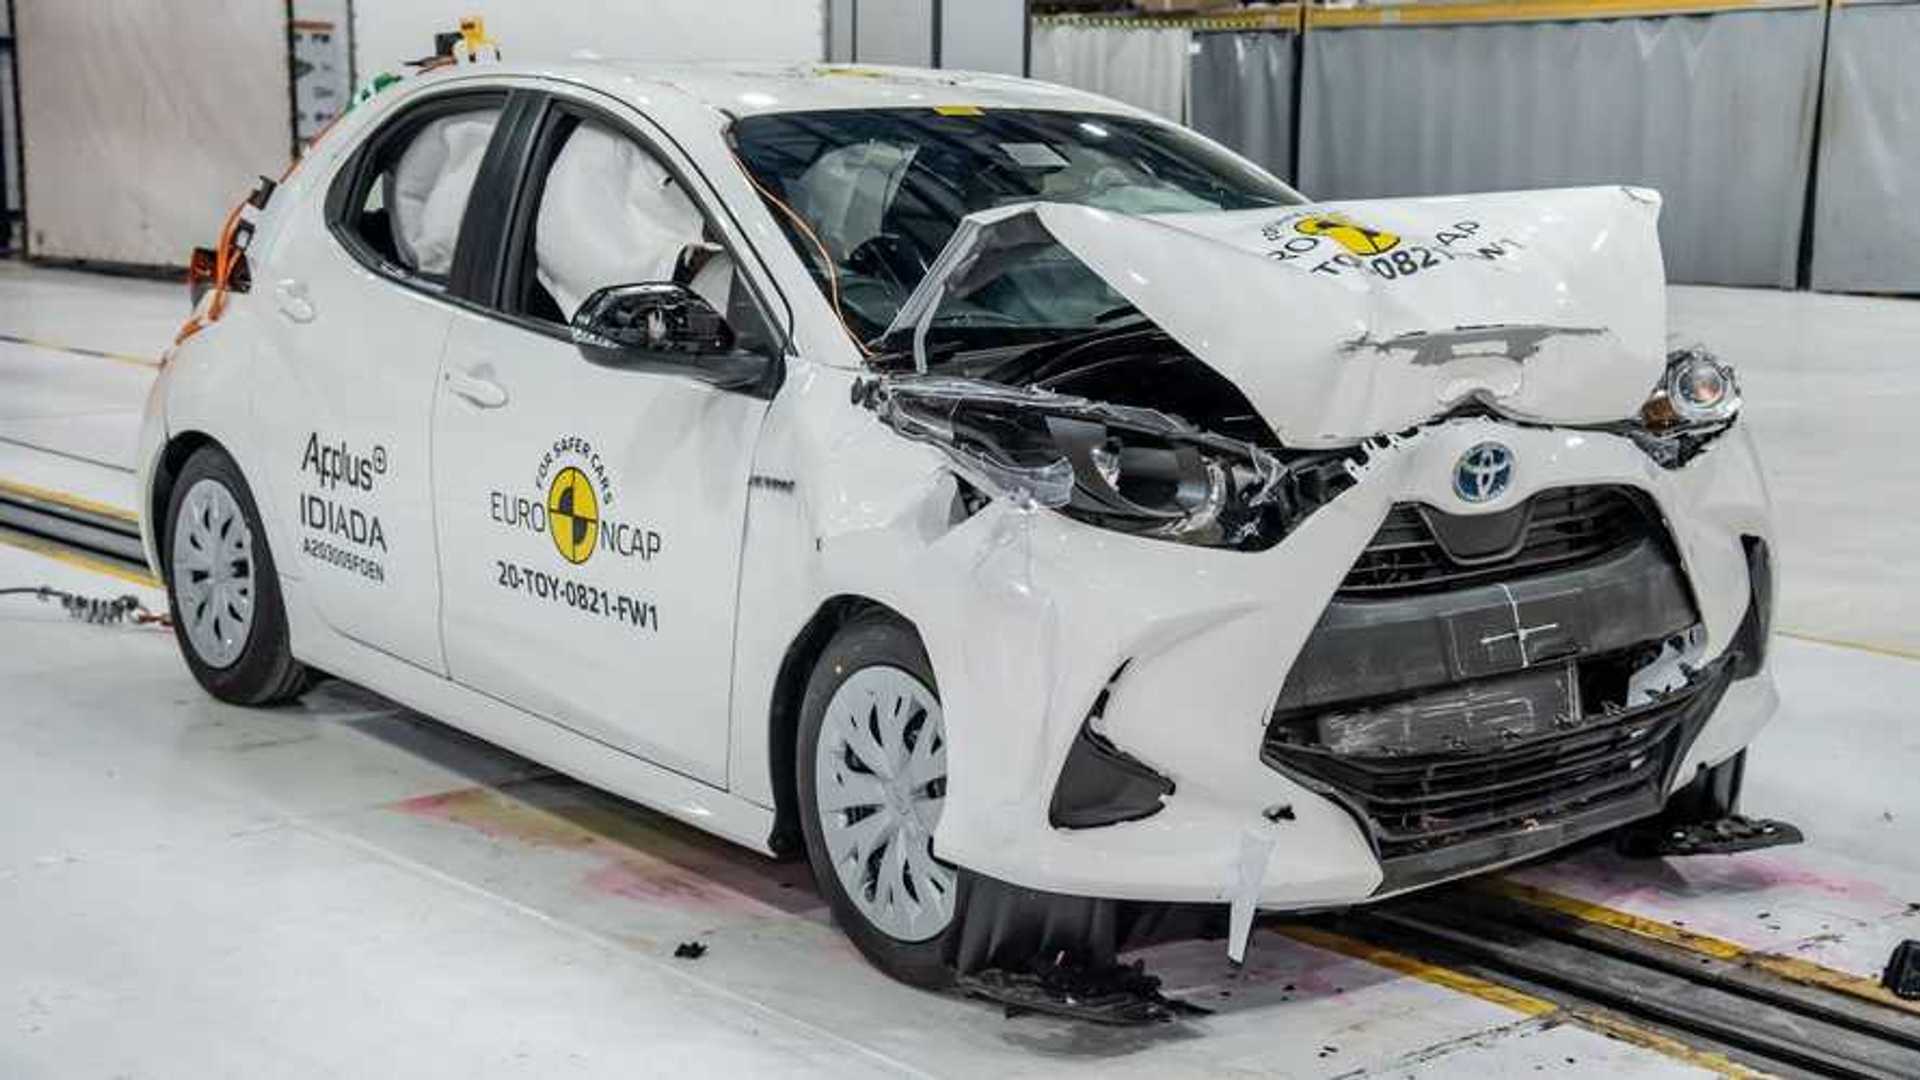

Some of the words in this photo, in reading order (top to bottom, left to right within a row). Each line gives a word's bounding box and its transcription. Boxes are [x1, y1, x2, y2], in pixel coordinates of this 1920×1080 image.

[301, 431, 373, 491] Applus
[553, 436, 591, 459] SAFER
[300, 492, 388, 553] IDIADA
[490, 491, 546, 533] EURO
[600, 520, 661, 561] NCAP
[497, 560, 659, 633] 20-TOY-0821-FW1
